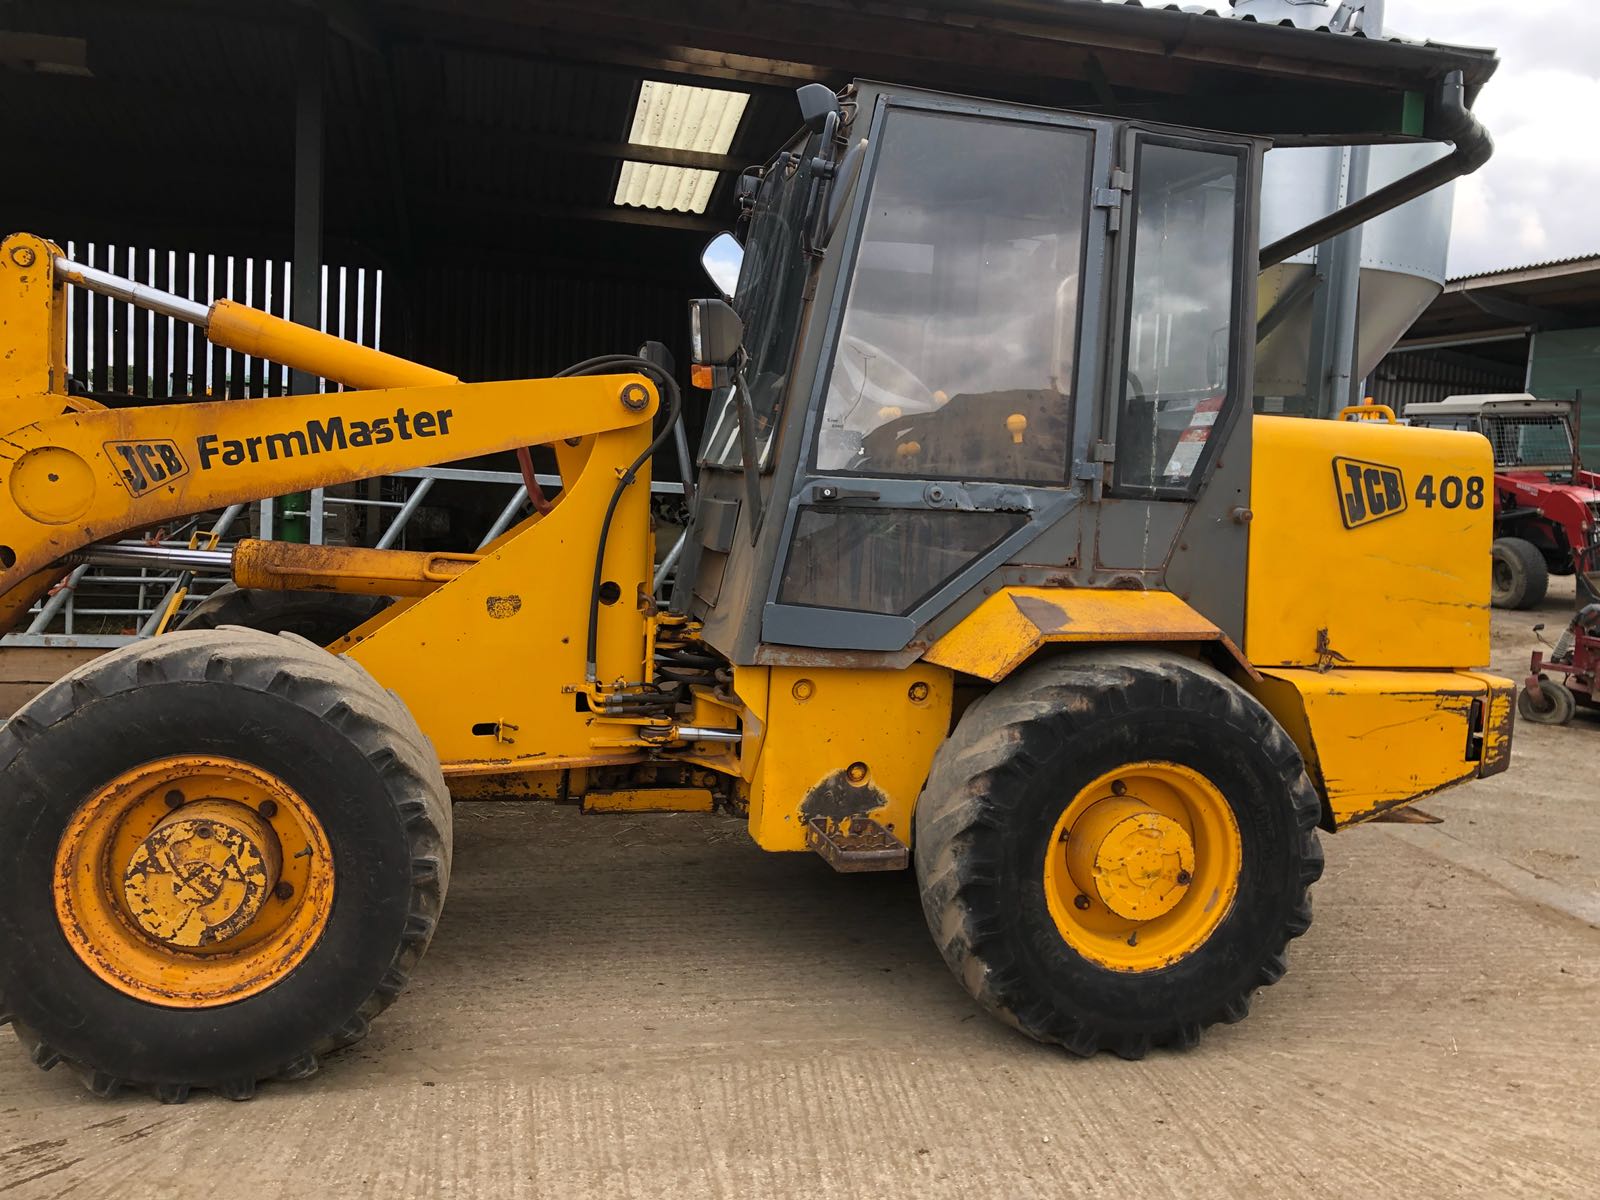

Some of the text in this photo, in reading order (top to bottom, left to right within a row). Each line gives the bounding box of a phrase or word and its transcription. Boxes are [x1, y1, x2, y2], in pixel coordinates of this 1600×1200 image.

[115, 408, 453, 492] JCB FarmMaster
[1345, 463, 1484, 523] JCB 408
